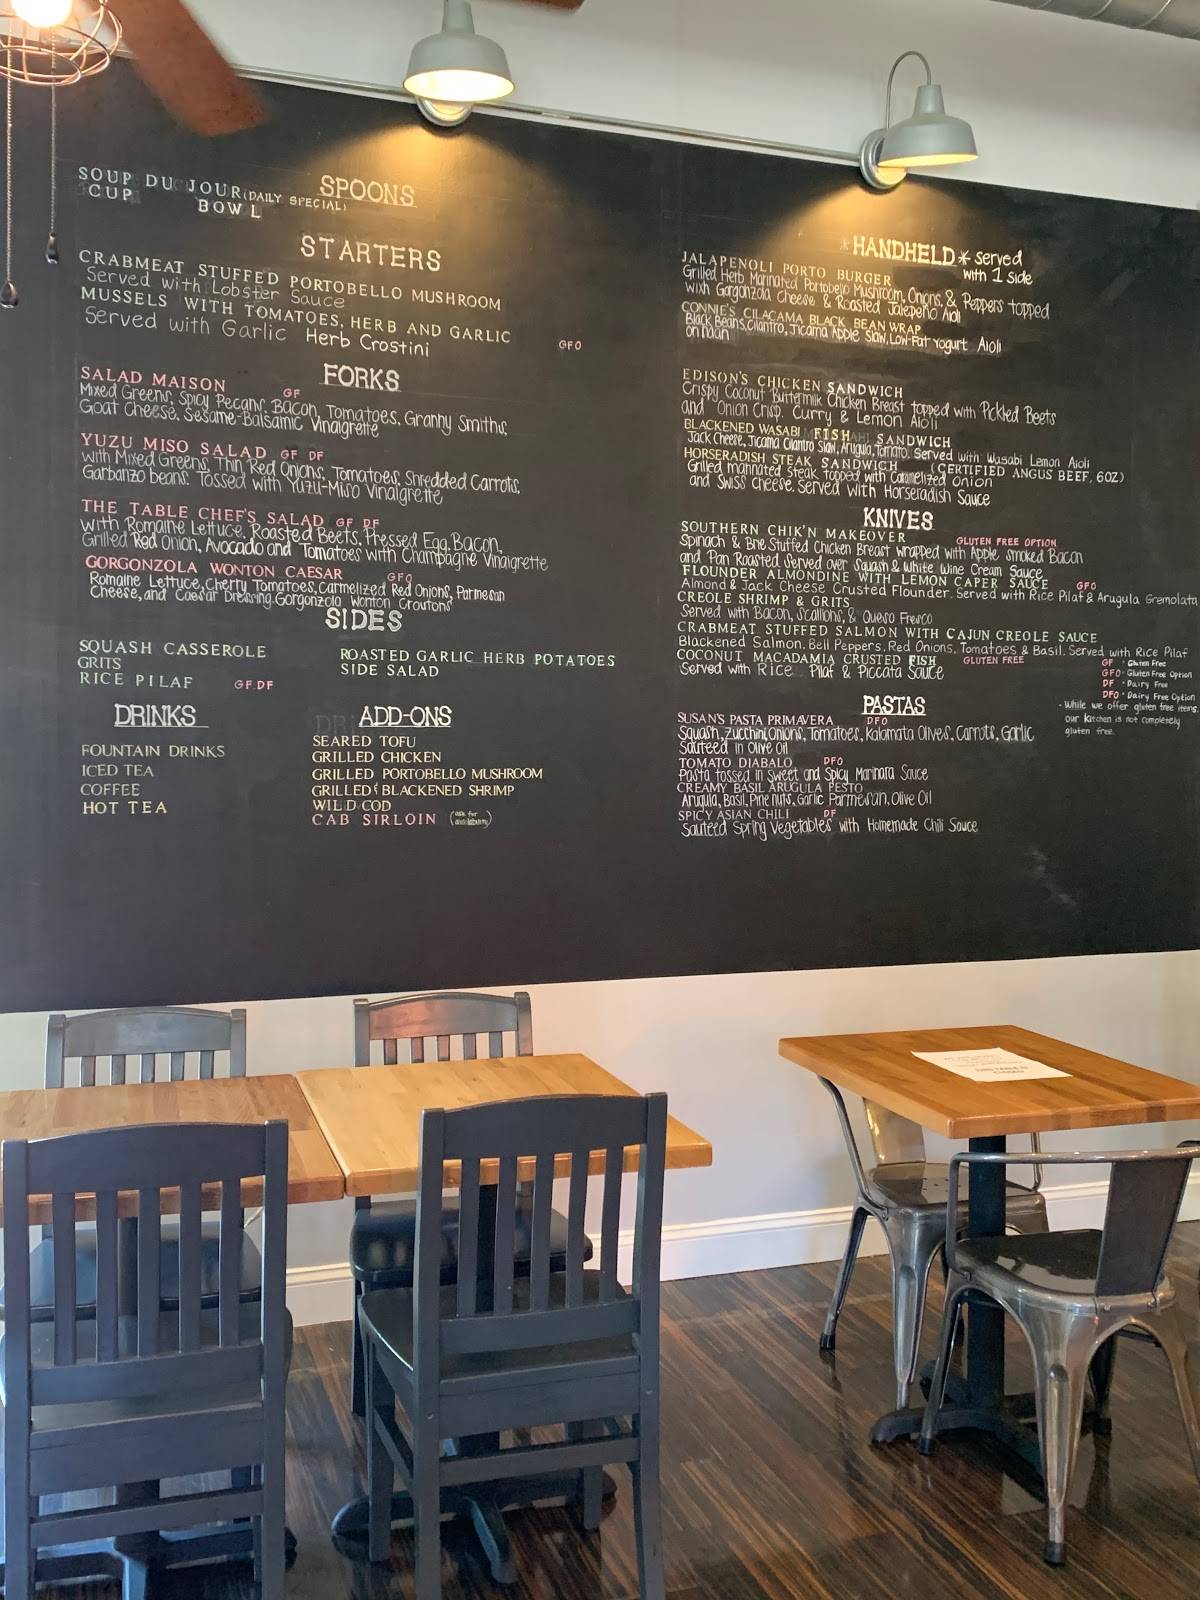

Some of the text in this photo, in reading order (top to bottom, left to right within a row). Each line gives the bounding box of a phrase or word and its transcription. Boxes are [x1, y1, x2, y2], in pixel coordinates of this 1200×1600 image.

[78, 166, 131, 185] SOUP
[146, 174, 173, 190] DU
[189, 179, 242, 199] JOUR
[320, 175, 415, 207] SPOONS
[89, 184, 132, 200] CUP
[300, 236, 441, 271] STARTERS
[974, 250, 1023, 267] served
[79, 250, 501, 310] CRABMEAT STUFFED PORTOBELLO MUSHROOM
[963, 267, 1033, 285] with 1 side
[87, 266, 345, 308] Served with Lobster Sauce
[81, 287, 167, 307] MUSSELS
[185, 297, 234, 314] WITH
[351, 316, 397, 333] HERB
[407, 322, 441, 337] AND
[450, 326, 511, 343] GARLIC
[85, 306, 429, 357] Served with Garlic Herb Crostini
[559, 340, 582, 350] GFO
[81, 366, 300, 398] SALAD MAISON GF
[324, 363, 400, 391] FORKS
[683, 368, 902, 398] EDISON'S CHICKEN SANDWICH
[81, 433, 133, 448] YUZU
[143, 437, 189, 453] MISO
[200, 442, 267, 459] SALAD
[281, 450, 298, 460] GF
[684, 447, 897, 471] HORSERADISH STEAK SANDWICH
[1012, 467, 1053, 480] ANGUS
[82, 499, 117, 514] THE
[129, 502, 189, 519] TABLE
[199, 507, 256, 524] CHEF'S
[267, 512, 323, 527] SALAD
[336, 518, 353, 527] GF
[862, 508, 935, 531] KNIVES
[681, 520, 759, 535] SOUTHERN
[826, 528, 906, 543] MAKEOVER
[956, 536, 991, 546] GLUTEN
[996, 537, 1019, 546] FREE
[1024, 537, 1057, 547] OPTION
[85, 555, 198, 574] GORGONZOLA
[210, 562, 275, 578] WONTON
[285, 565, 343, 580] CAESAR
[683, 564, 1097, 590] FLOUNDER ALMONDINE WITH LEMON CAPER SAUCE GFO
[677, 591, 850, 608] CREOLE SHRIMP & GRITS
[325, 608, 403, 632] SIDES
[678, 621, 1097, 643] CRABMEAT STUFFED SALMON WITH CAJUN CREOLE SAUCE
[80, 640, 266, 659] SQUASH CASSEROLE
[340, 649, 616, 667] ROASTED GARLIC HERB POTATOES
[677, 650, 1025, 666] COCONUT MACADAMIA CRUSTED FISH GLUTEN FREE
[77, 657, 121, 670] GRITS
[341, 663, 439, 677] SIDE SALAD
[80, 672, 124, 685] RICE
[136, 674, 193, 688] PILAF
[863, 695, 926, 715] PASTAS
[114, 704, 197, 727] DRINKS
[359, 705, 452, 726] ADD-ONS
[678, 711, 725, 725] SUSAN'S
[730, 714, 763, 726] PASTA
[768, 714, 834, 726] PRIMAVERA
[312, 735, 417, 748] SEARED TOFU
[81, 744, 225, 758] FOUNTAIN DRINKS
[312, 751, 441, 763] GRILLED CHICKEN
[82, 764, 154, 777] ICED TEA
[678, 758, 731, 769] TOMATO
[739, 757, 793, 768] DIABALO
[312, 768, 543, 781] GRILLED PORTOBELLO MUSHROOM
[80, 783, 140, 797] COFFEE
[312, 785, 371, 797] GRILLED
[382, 785, 462, 797] BLACKENED
[469, 785, 515, 796] SHRIMP
[82, 801, 167, 814] HOT TEA
[312, 800, 391, 812] WILD COD
[312, 814, 349, 826] CAB
[362, 814, 437, 826] SIRLOIN
